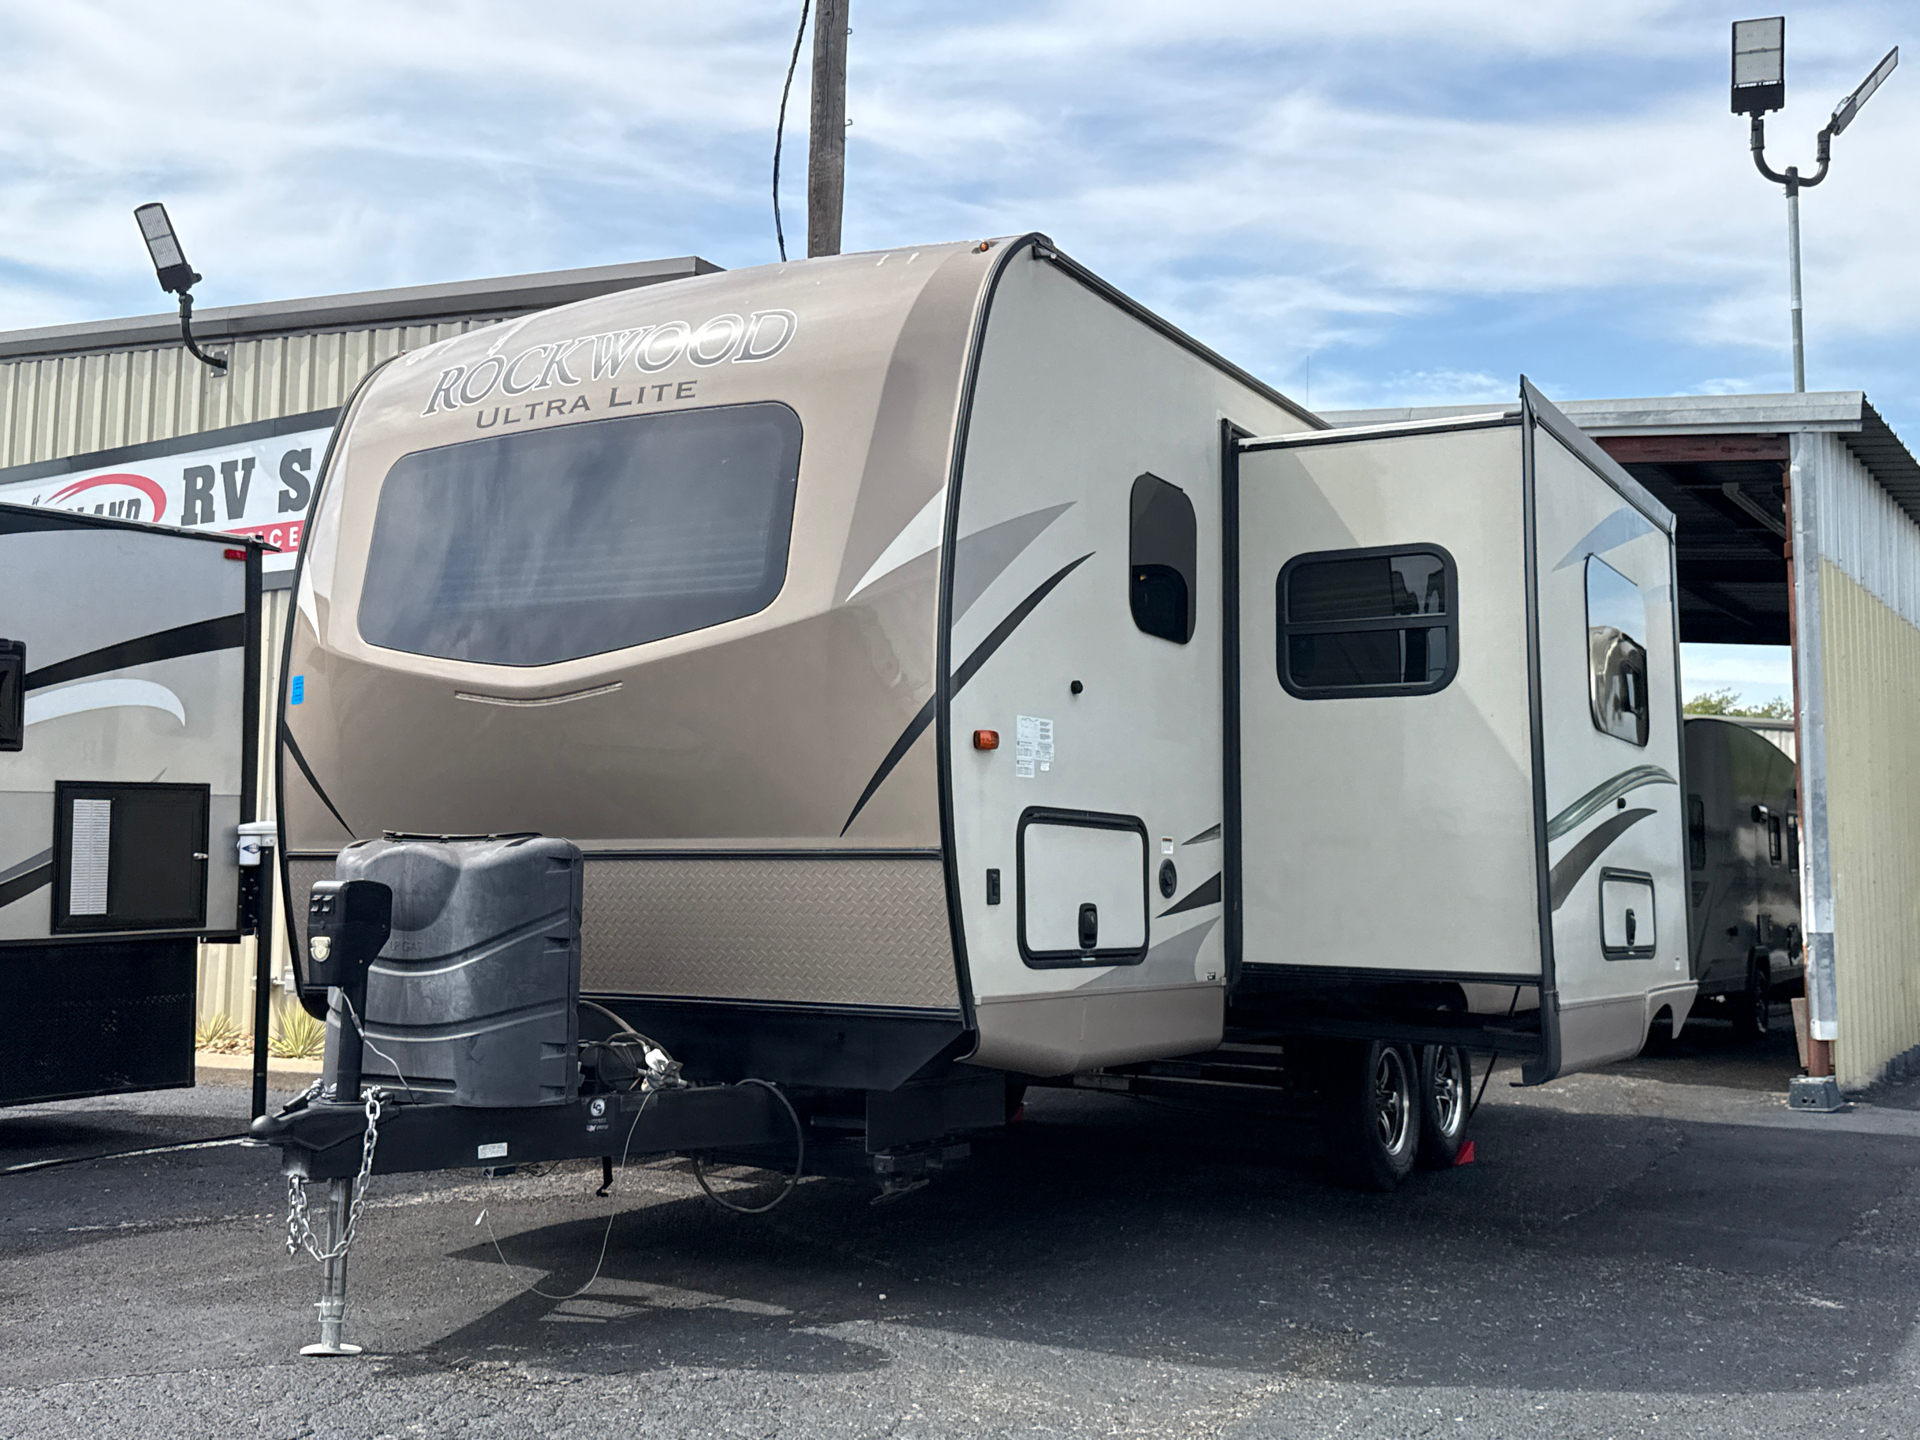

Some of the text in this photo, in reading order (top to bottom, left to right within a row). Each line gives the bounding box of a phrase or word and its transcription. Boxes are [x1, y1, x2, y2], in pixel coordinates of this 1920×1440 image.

[420, 308, 798, 418] ROCKWOOD
[476, 379, 699, 429] ULTRA LITE
[180, 456, 257, 527] RV
